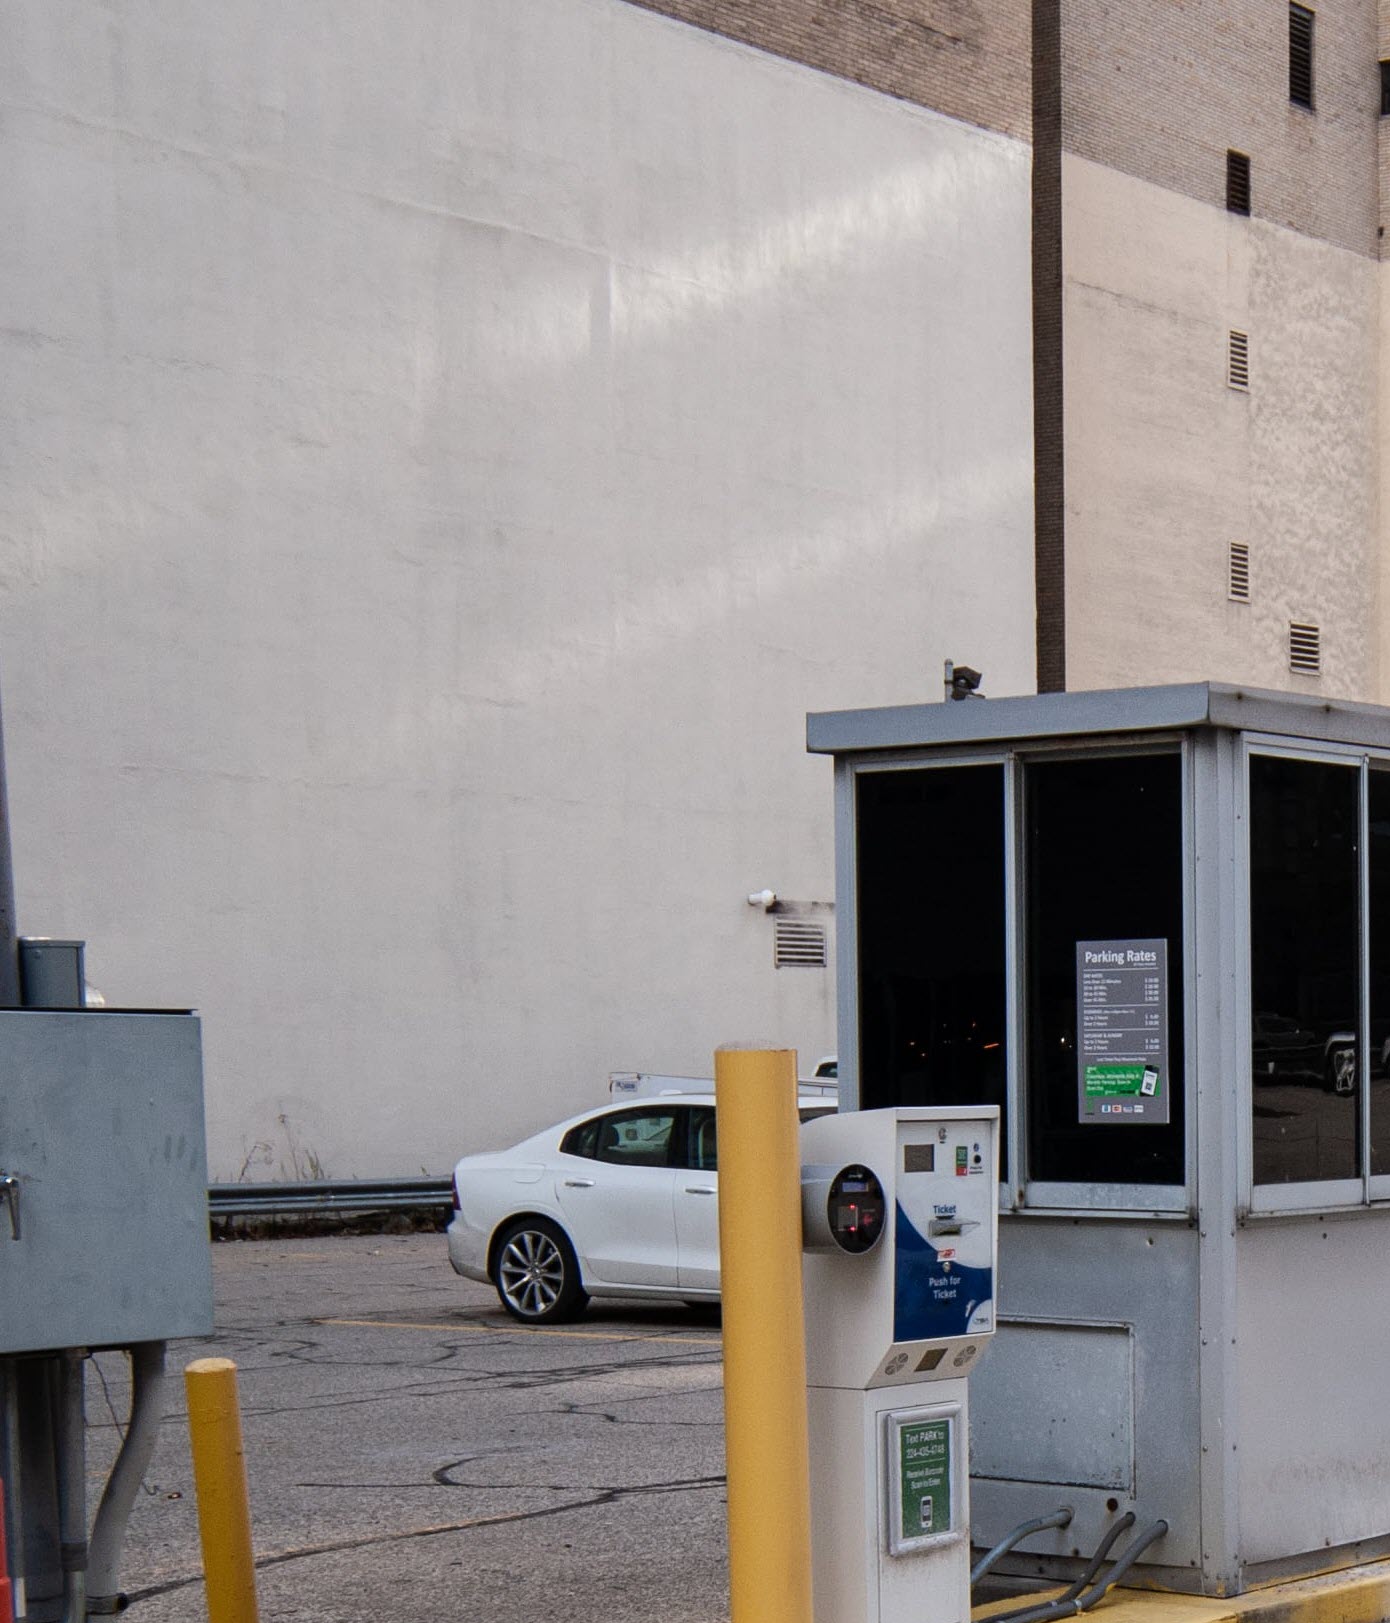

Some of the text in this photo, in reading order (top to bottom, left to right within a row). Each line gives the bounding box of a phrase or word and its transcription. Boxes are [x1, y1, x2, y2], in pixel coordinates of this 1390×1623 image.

[1085, 951, 1125, 965] Parking
[1127, 950, 1157, 962] Rates
[933, 1204, 957, 1214] Ticket
[928, 1276, 962, 1287] Push for
[933, 1289, 957, 1300] Ticket
[919, 1431, 938, 1442] PARK
